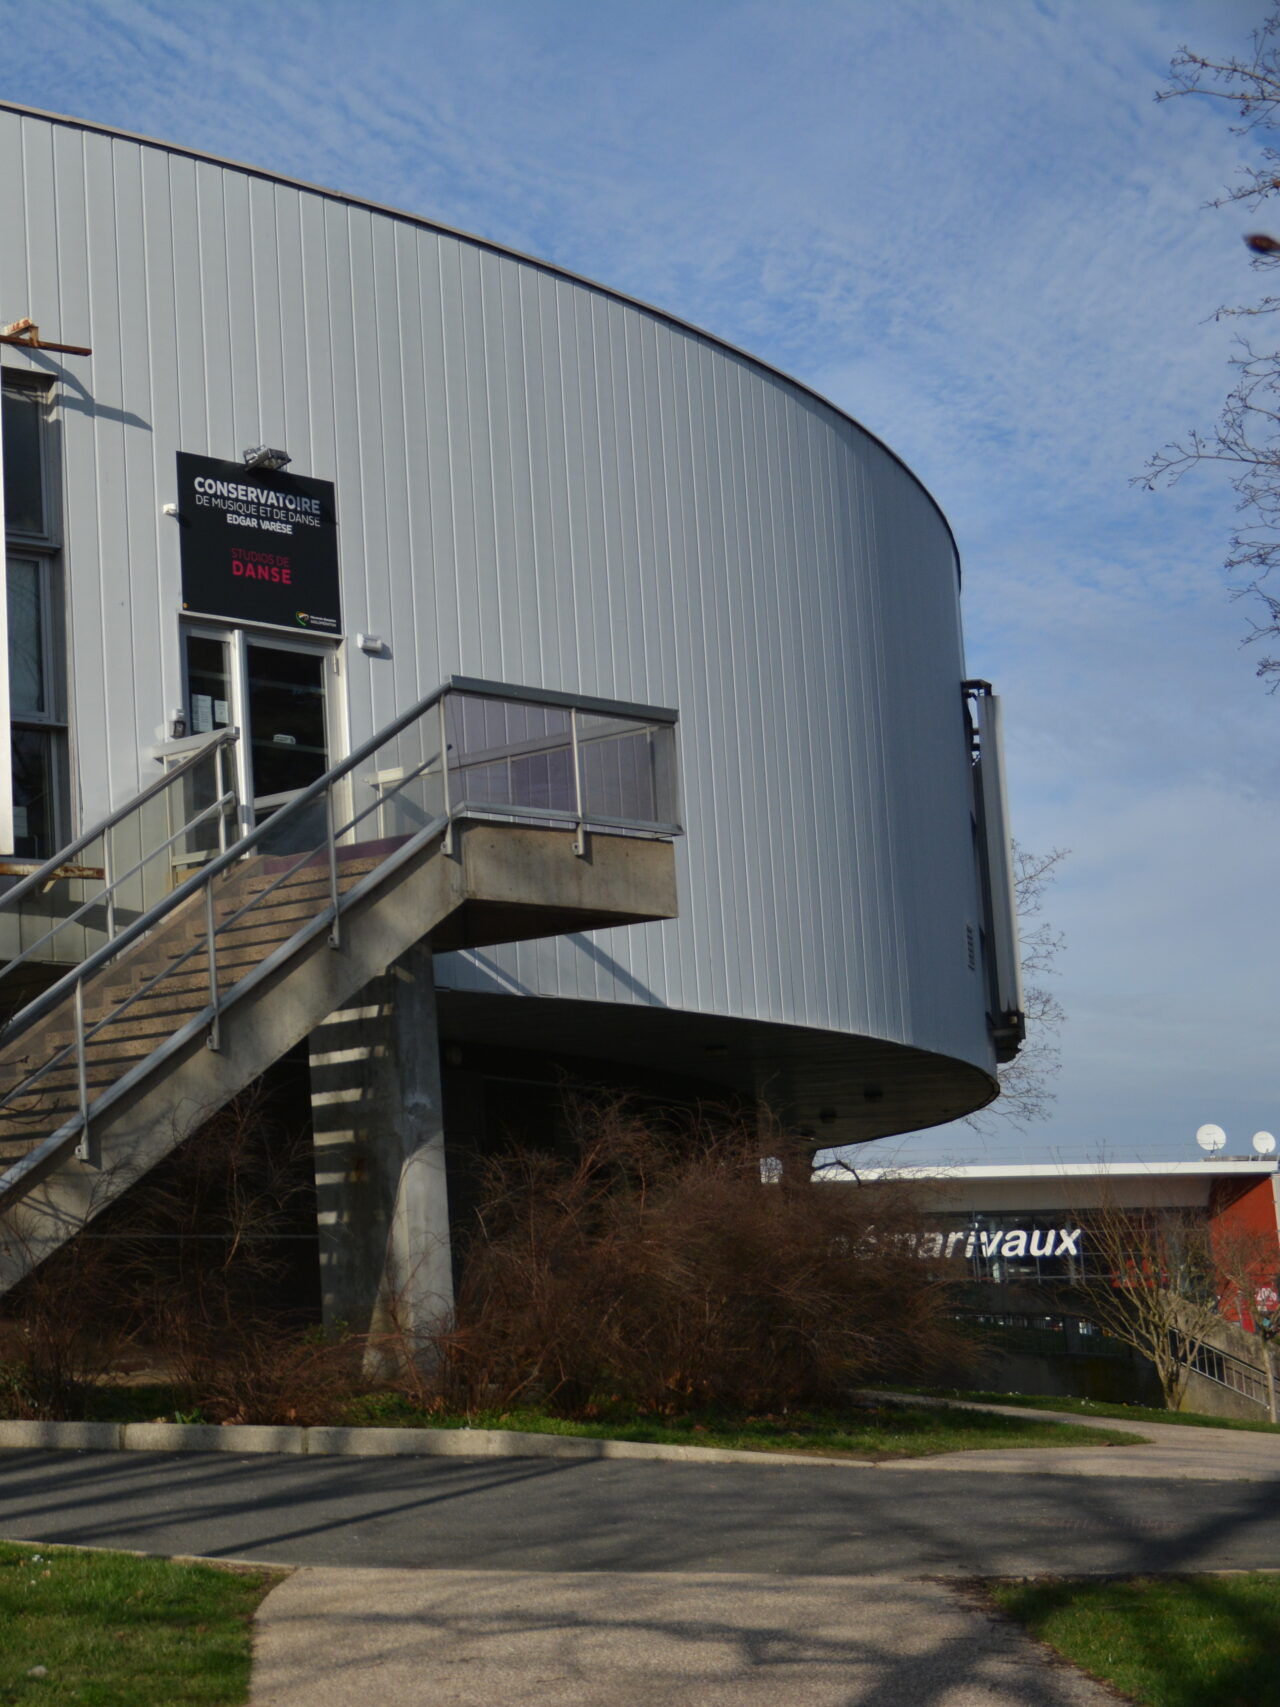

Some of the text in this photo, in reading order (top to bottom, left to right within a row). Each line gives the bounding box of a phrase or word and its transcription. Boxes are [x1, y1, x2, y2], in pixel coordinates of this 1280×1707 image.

[194, 477, 320, 514] CONSERVATOIRE
[195, 494, 320, 527] DE MUSIQUE ET DE DANSE
[226, 513, 293, 535] EDGAR VARÈSE
[231, 548, 289, 567] STUDIOS DE
[232, 560, 291, 584] DANSE
